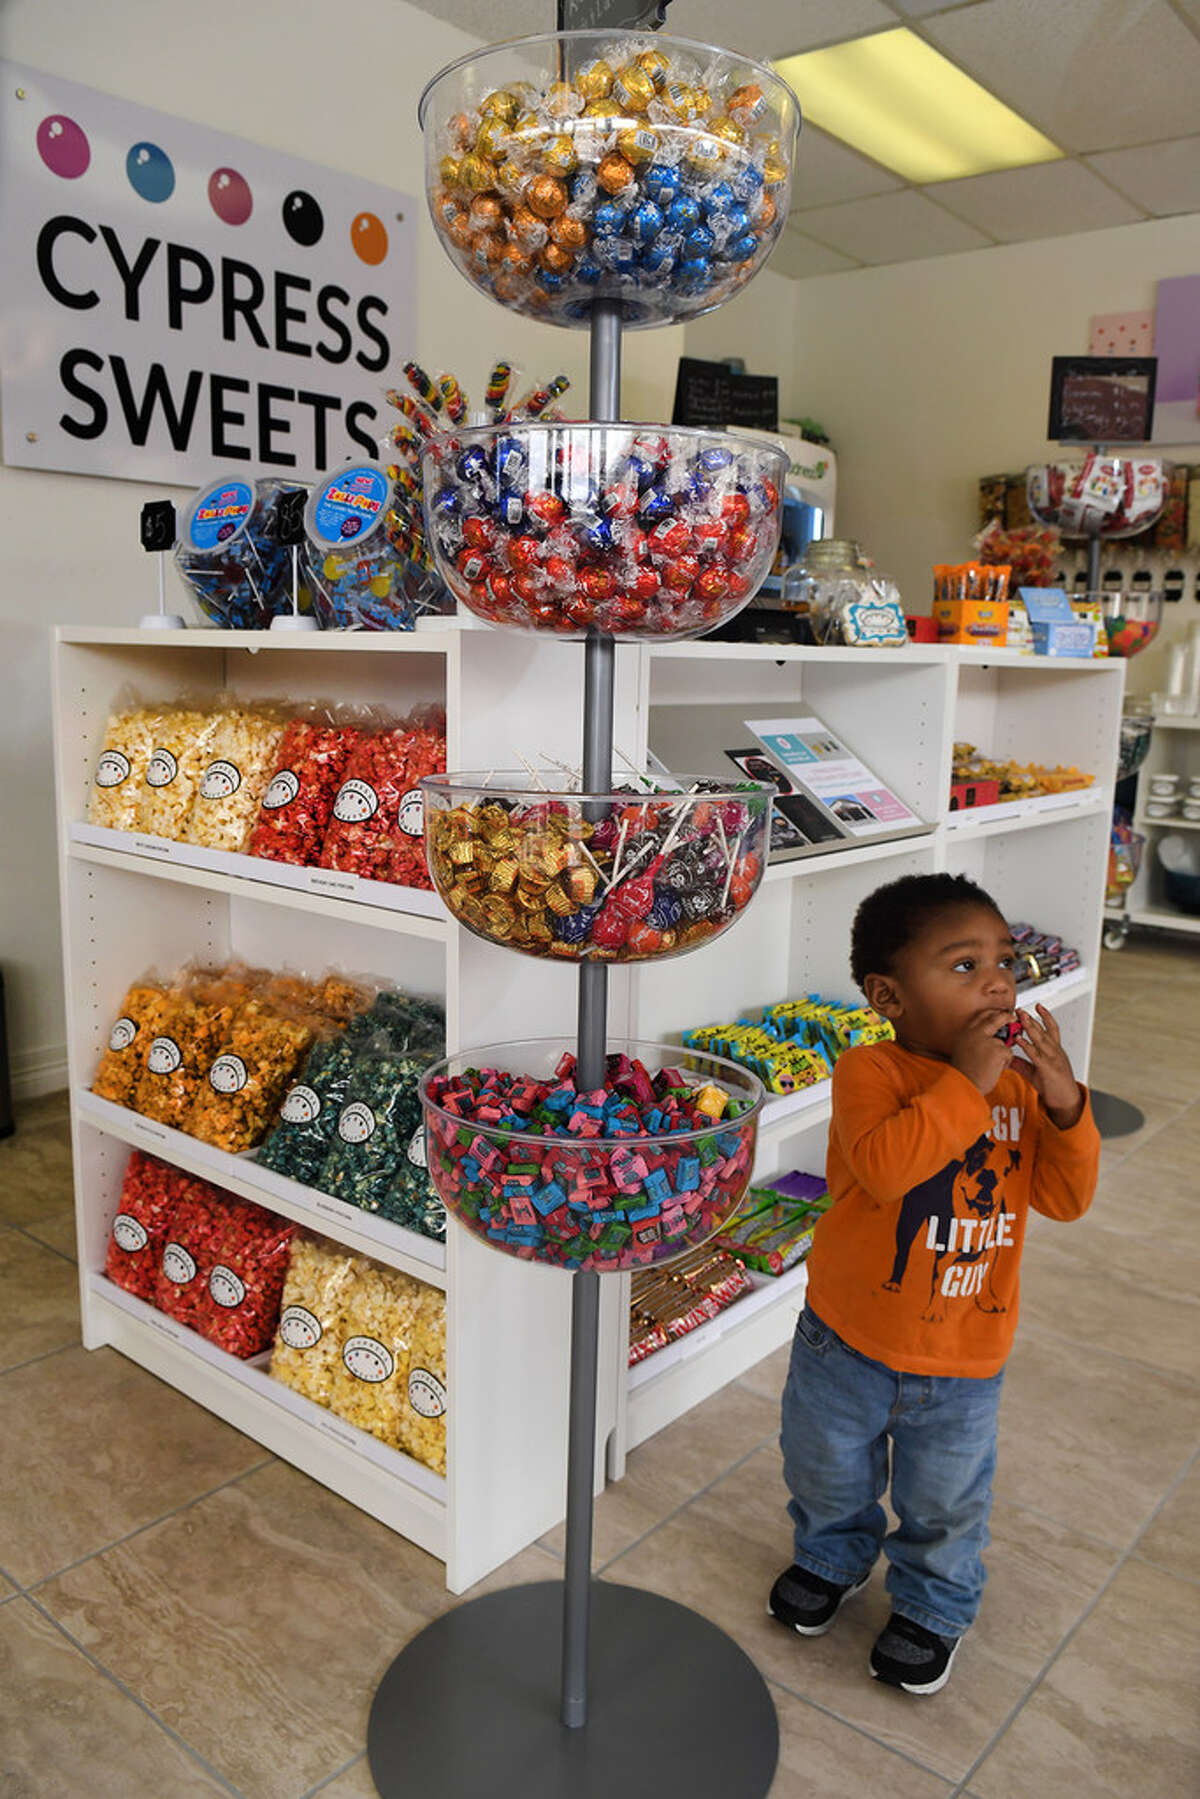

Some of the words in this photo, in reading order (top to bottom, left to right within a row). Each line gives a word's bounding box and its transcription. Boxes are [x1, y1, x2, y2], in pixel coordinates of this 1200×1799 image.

[36, 215, 390, 373] CYPRESS
[59, 348, 380, 471] SWEETS
[925, 1212, 1016, 1254] LITTLE
[940, 1261, 989, 1298] GUY
